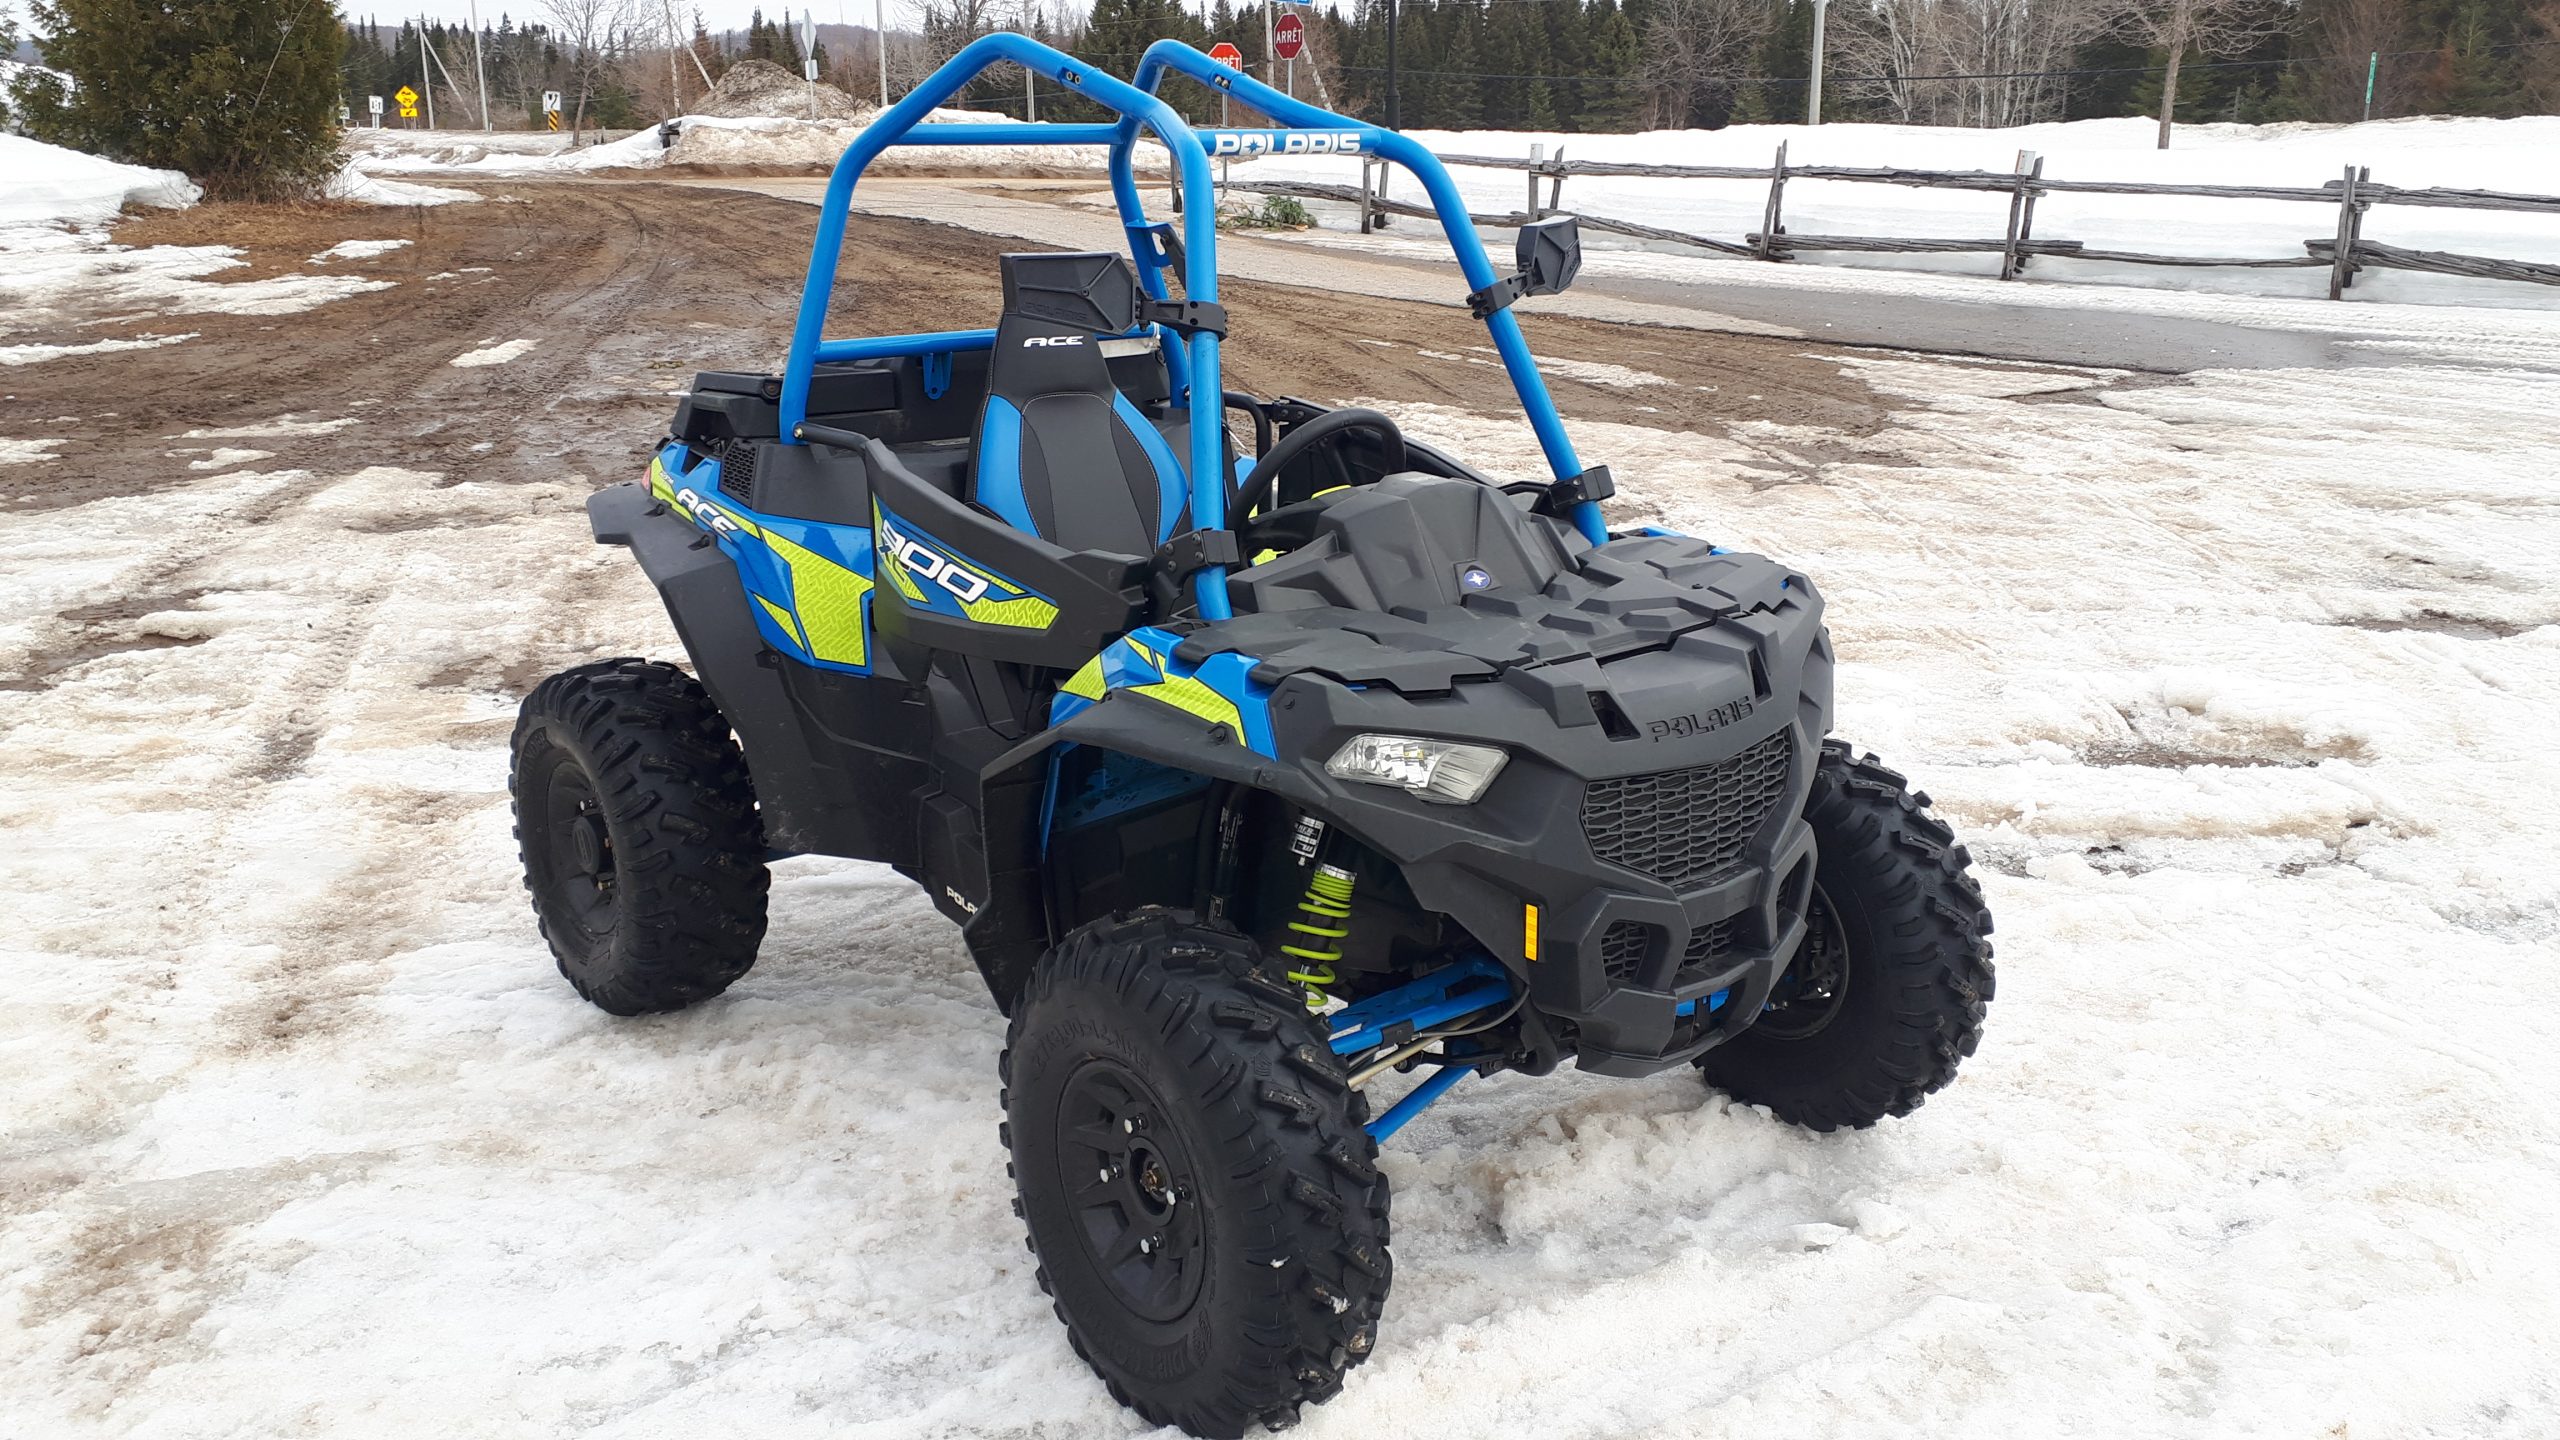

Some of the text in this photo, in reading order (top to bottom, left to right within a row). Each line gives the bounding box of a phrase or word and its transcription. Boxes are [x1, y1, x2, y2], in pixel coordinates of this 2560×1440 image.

[1276, 27, 1302, 44] ARRÊT
[1213, 133, 1361, 155] POLARIS
[1023, 335, 1084, 348] ACE
[676, 488, 740, 543] ACE
[880, 519, 990, 603] 900
[1646, 695, 1754, 743] POLARIS
[946, 885, 978, 915] POLA
